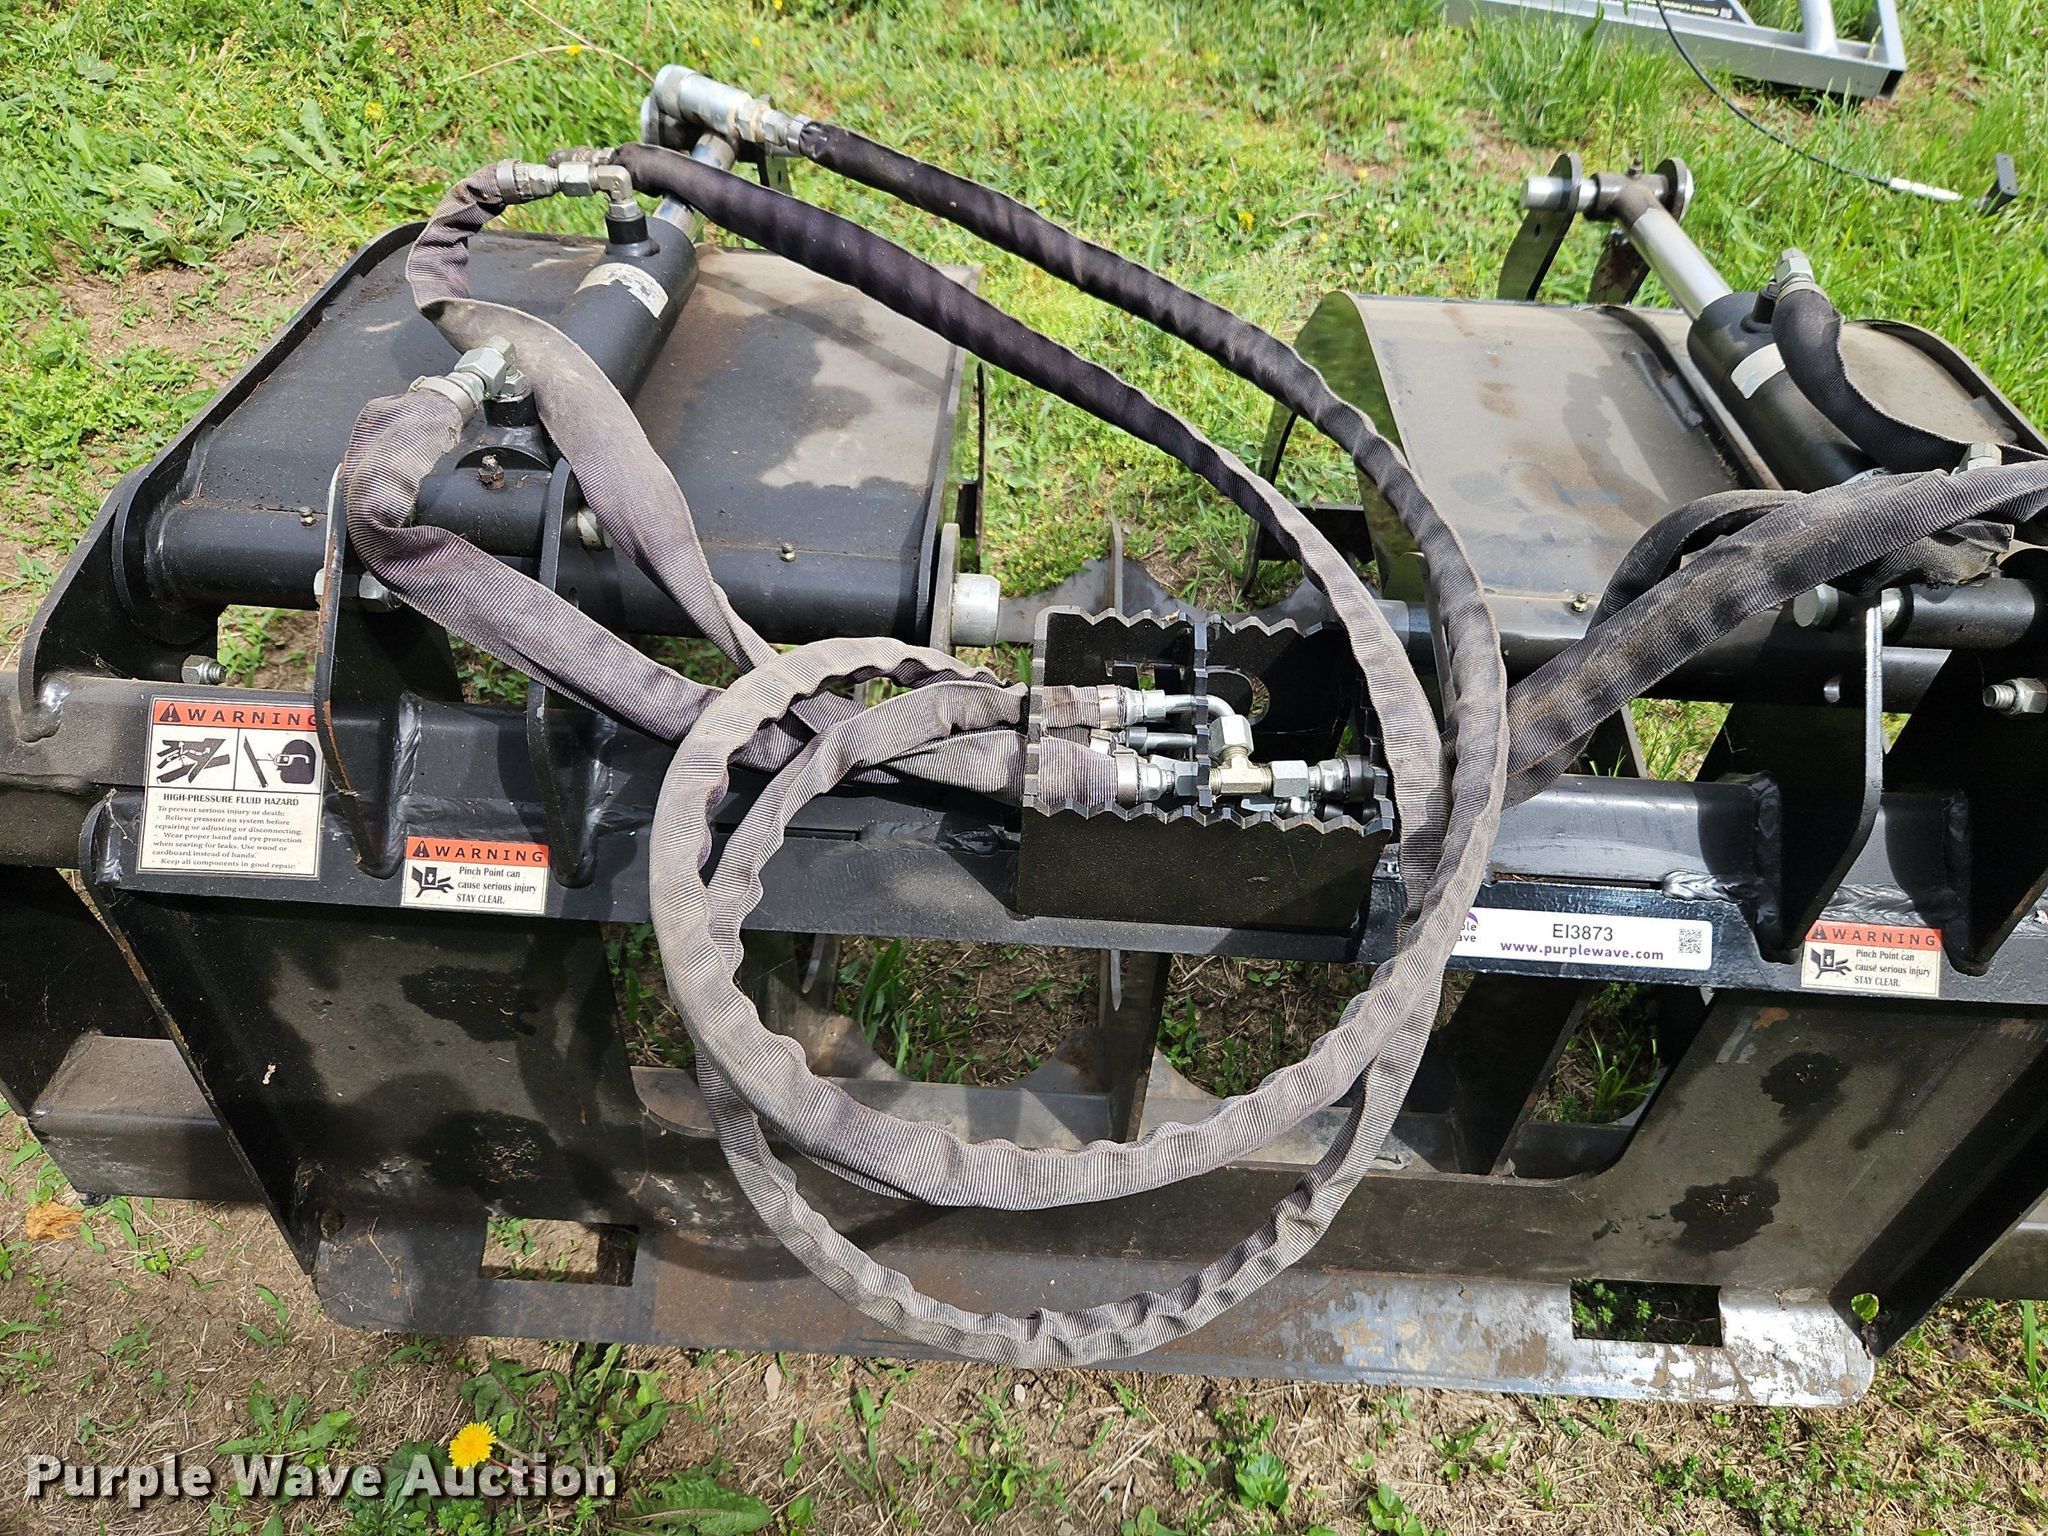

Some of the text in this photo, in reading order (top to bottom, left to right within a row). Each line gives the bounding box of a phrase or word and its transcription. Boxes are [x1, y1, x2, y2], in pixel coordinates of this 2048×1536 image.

[163, 793, 299, 806] HIGH-PRESSURE FLUID HAZARD
[226, 808, 250, 816] injury
[238, 818, 265, 826] system
[266, 818, 291, 826] before
[201, 825, 237, 833] adjusting
[212, 833, 231, 841] hand
[263, 836, 302, 844] protection
[435, 846, 544, 862] WARNING
[160, 858, 180, 866] Keep
[192, 860, 239, 868] components
[459, 866, 520, 878] Pinch Point can
[457, 881, 537, 894] cause serious injury
[456, 894, 505, 904] STAY CLEAR.
[1456, 934, 1477, 942] ave
[1552, 924, 1614, 942] EI3873
[1832, 928, 1936, 946] WARNING
[1500, 941, 1664, 961] www.purplewave.com
[1855, 949, 1877, 959] Pinch
[1879, 951, 1899, 960] Point
[1855, 964, 1930, 977] cause serious injury
[1853, 976, 1901, 987] STAY CLEAR.
